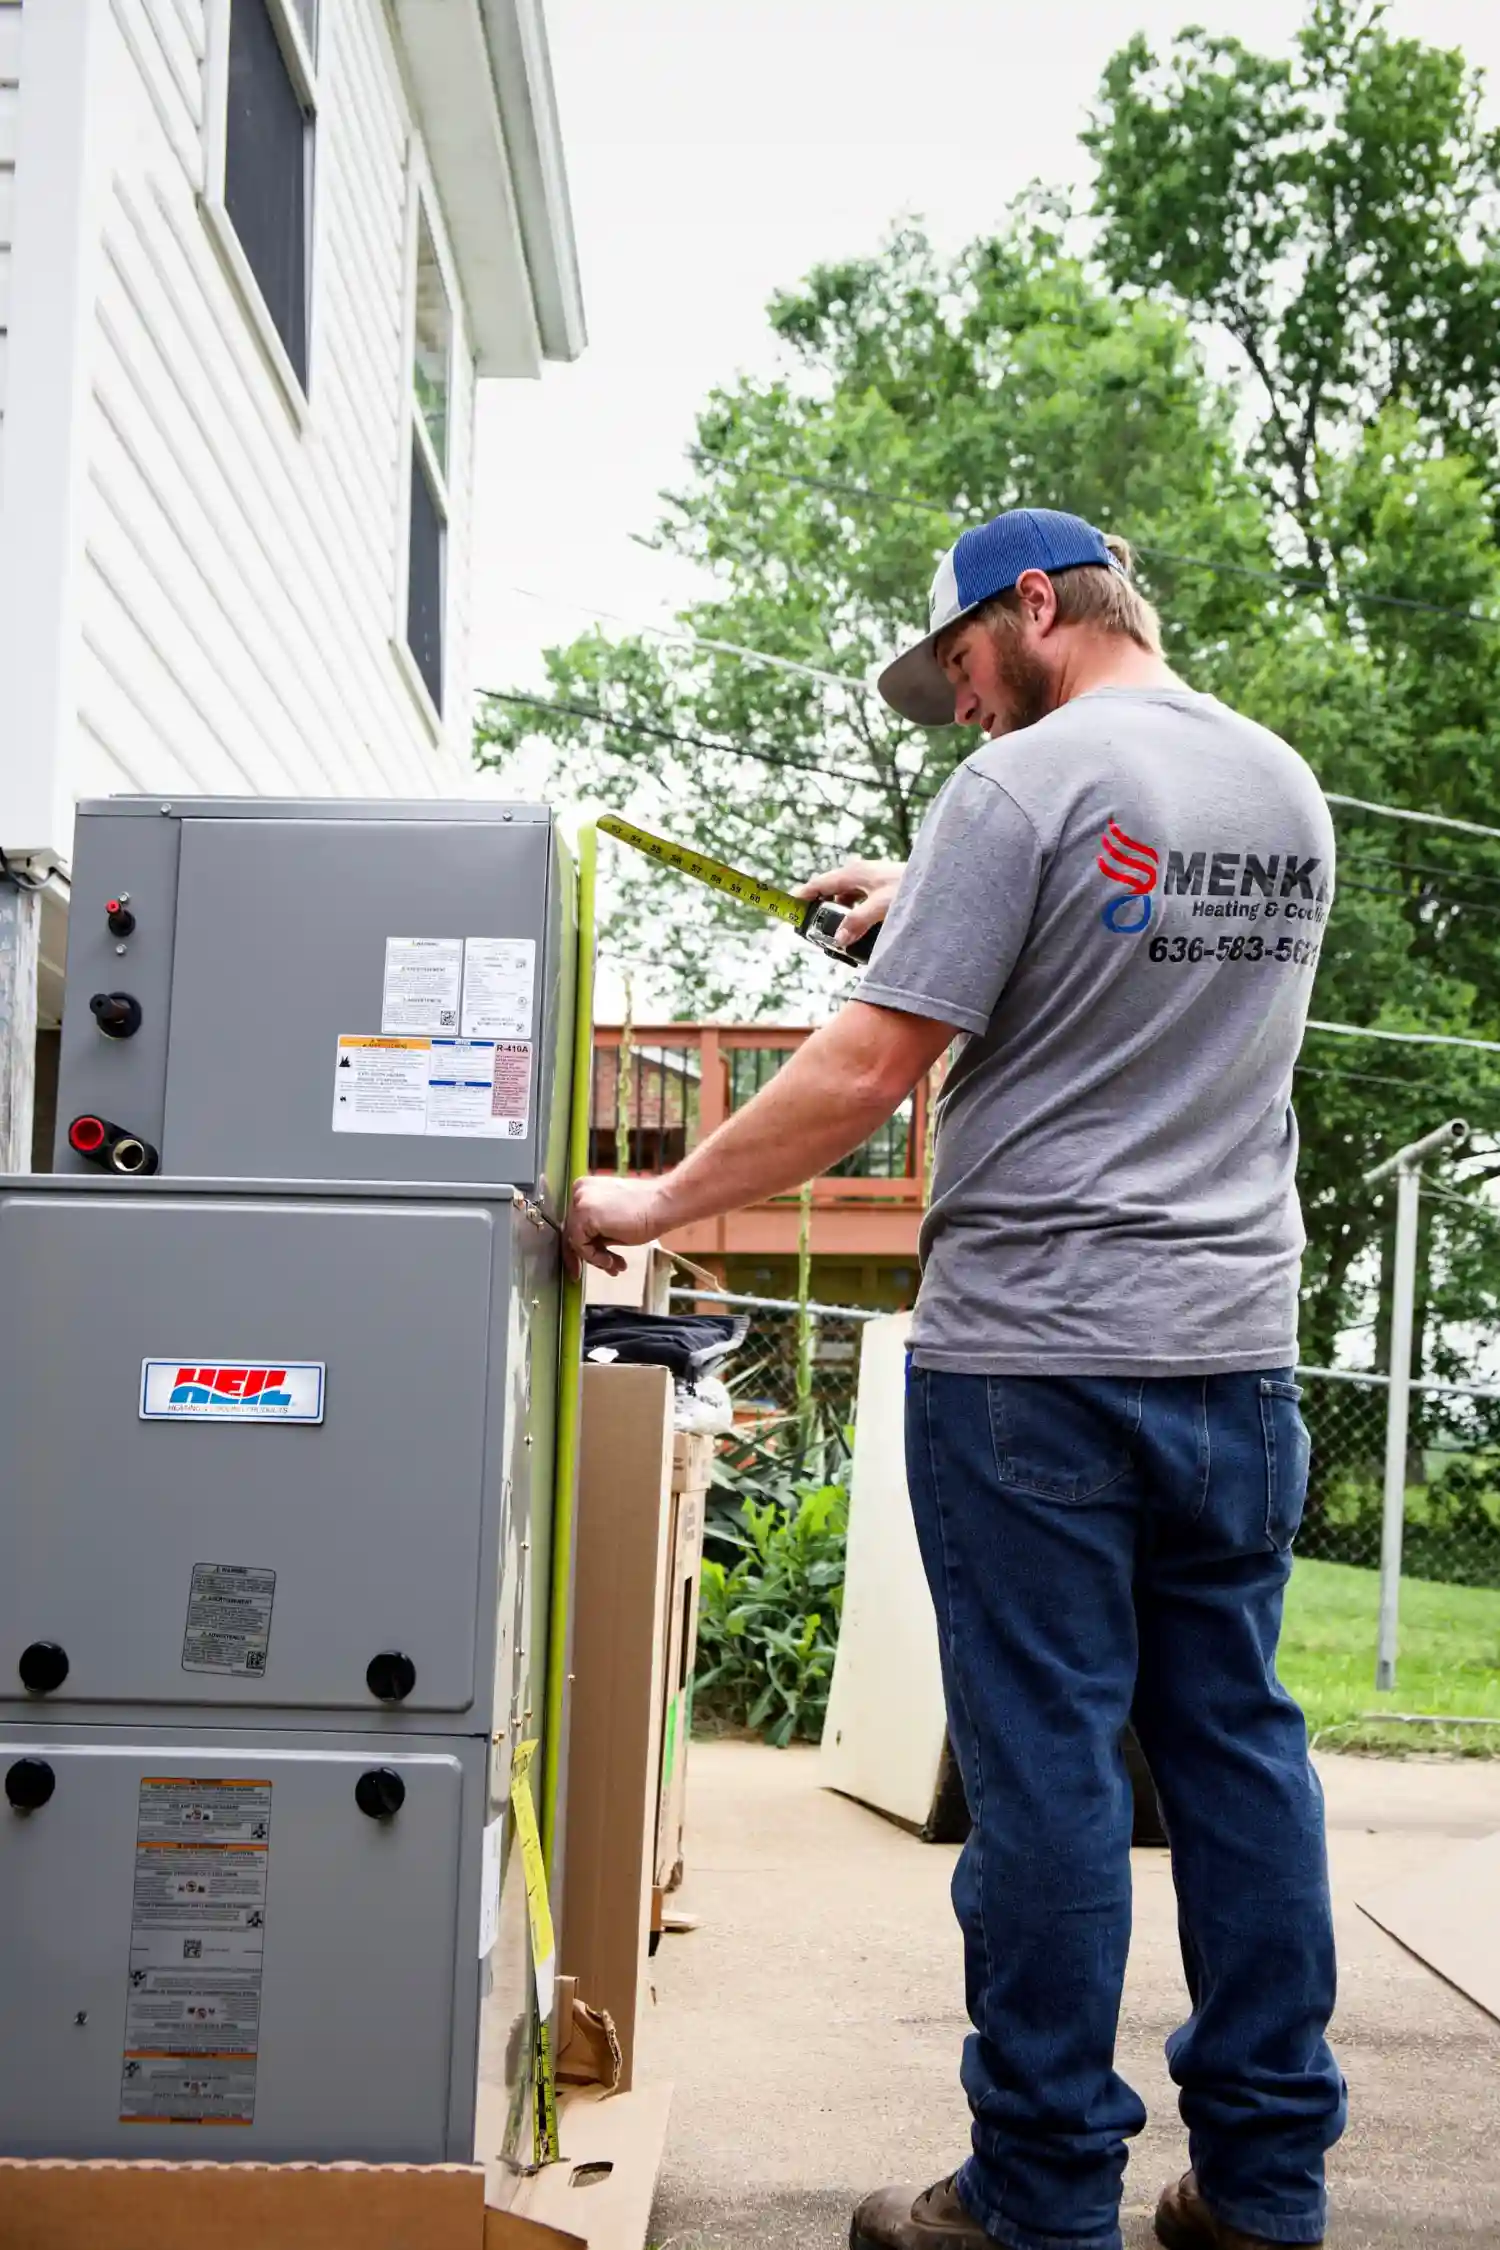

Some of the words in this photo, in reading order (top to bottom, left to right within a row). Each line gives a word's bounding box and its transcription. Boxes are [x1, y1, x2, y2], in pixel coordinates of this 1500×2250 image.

[1192, 901, 1260, 921] Heating
[1264, 902, 1279, 917] &
[496, 1044, 529, 1053] R-410A
[169, 1368, 292, 1406] HEIL
